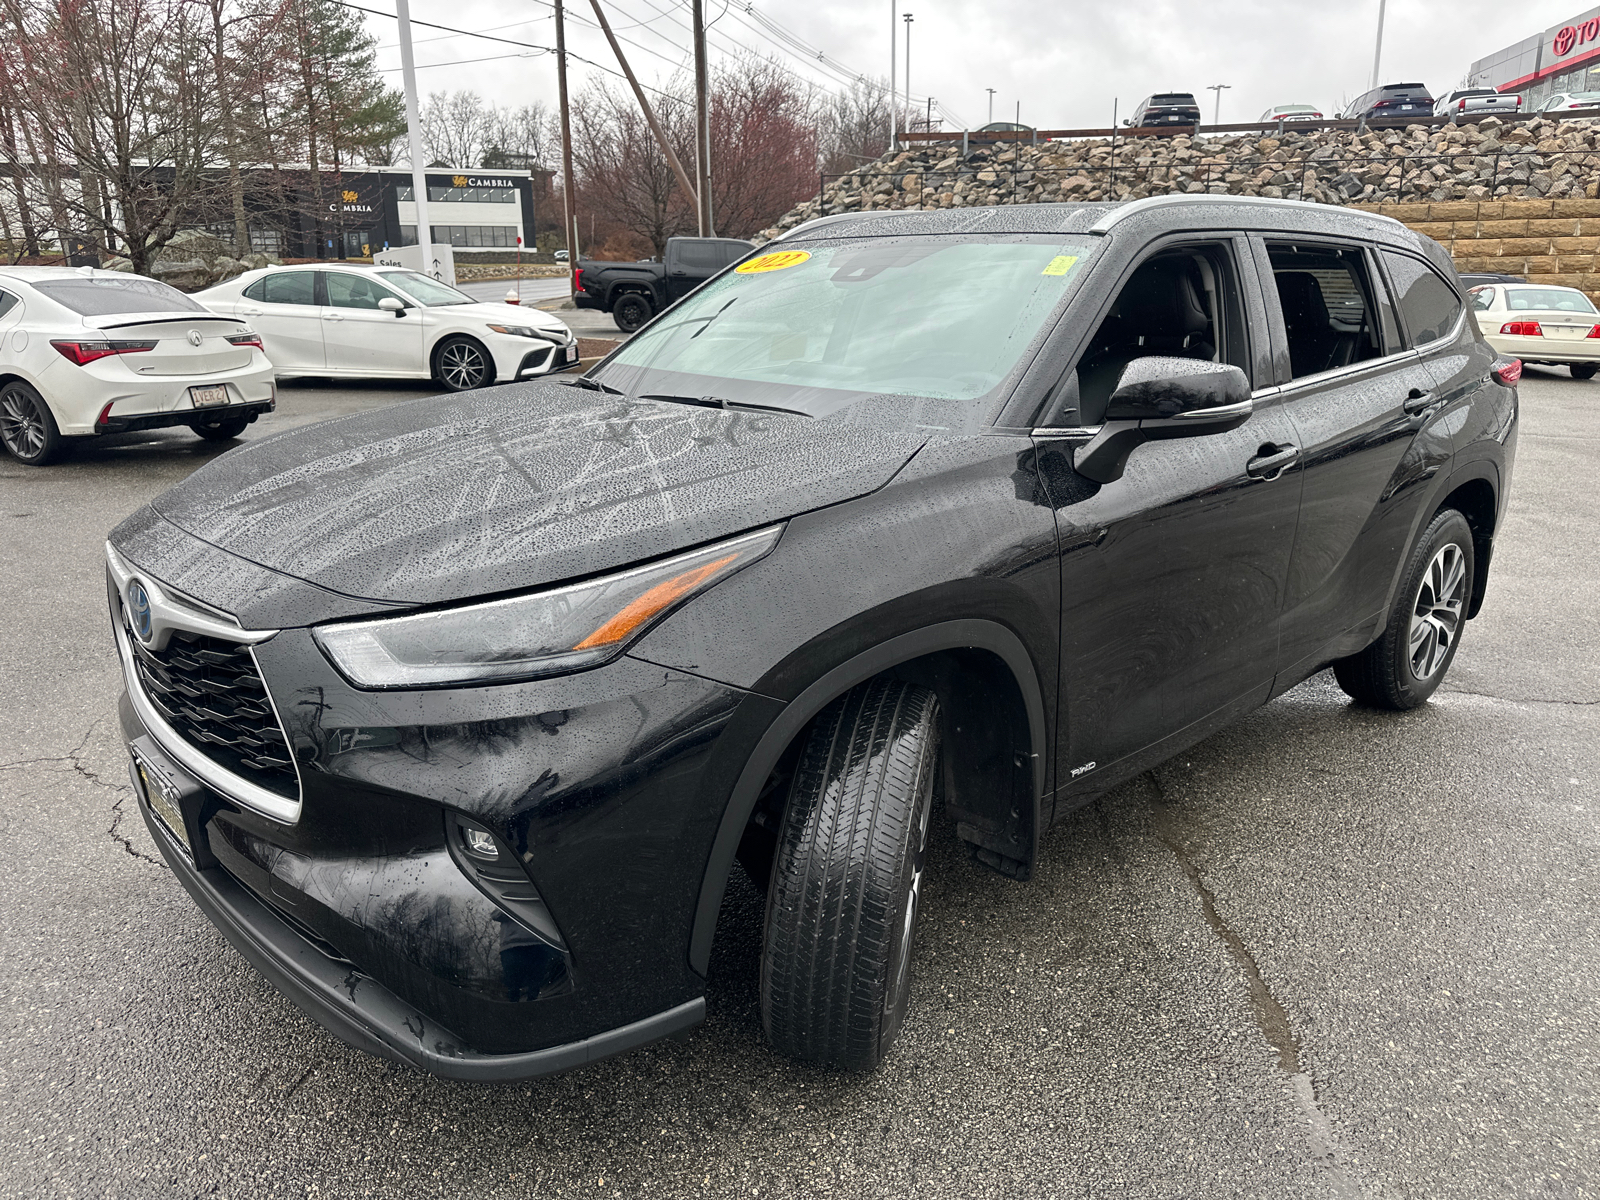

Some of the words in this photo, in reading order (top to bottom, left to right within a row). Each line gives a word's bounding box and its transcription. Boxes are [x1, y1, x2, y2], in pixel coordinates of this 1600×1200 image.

[1577, 15, 1600, 45] TO
[468, 178, 514, 187] CAMBRIA
[329, 203, 373, 212] CMBRIA
[380, 259, 402, 268] Sales
[741, 253, 802, 271] 2022
[194, 391, 215, 403] 1VER
